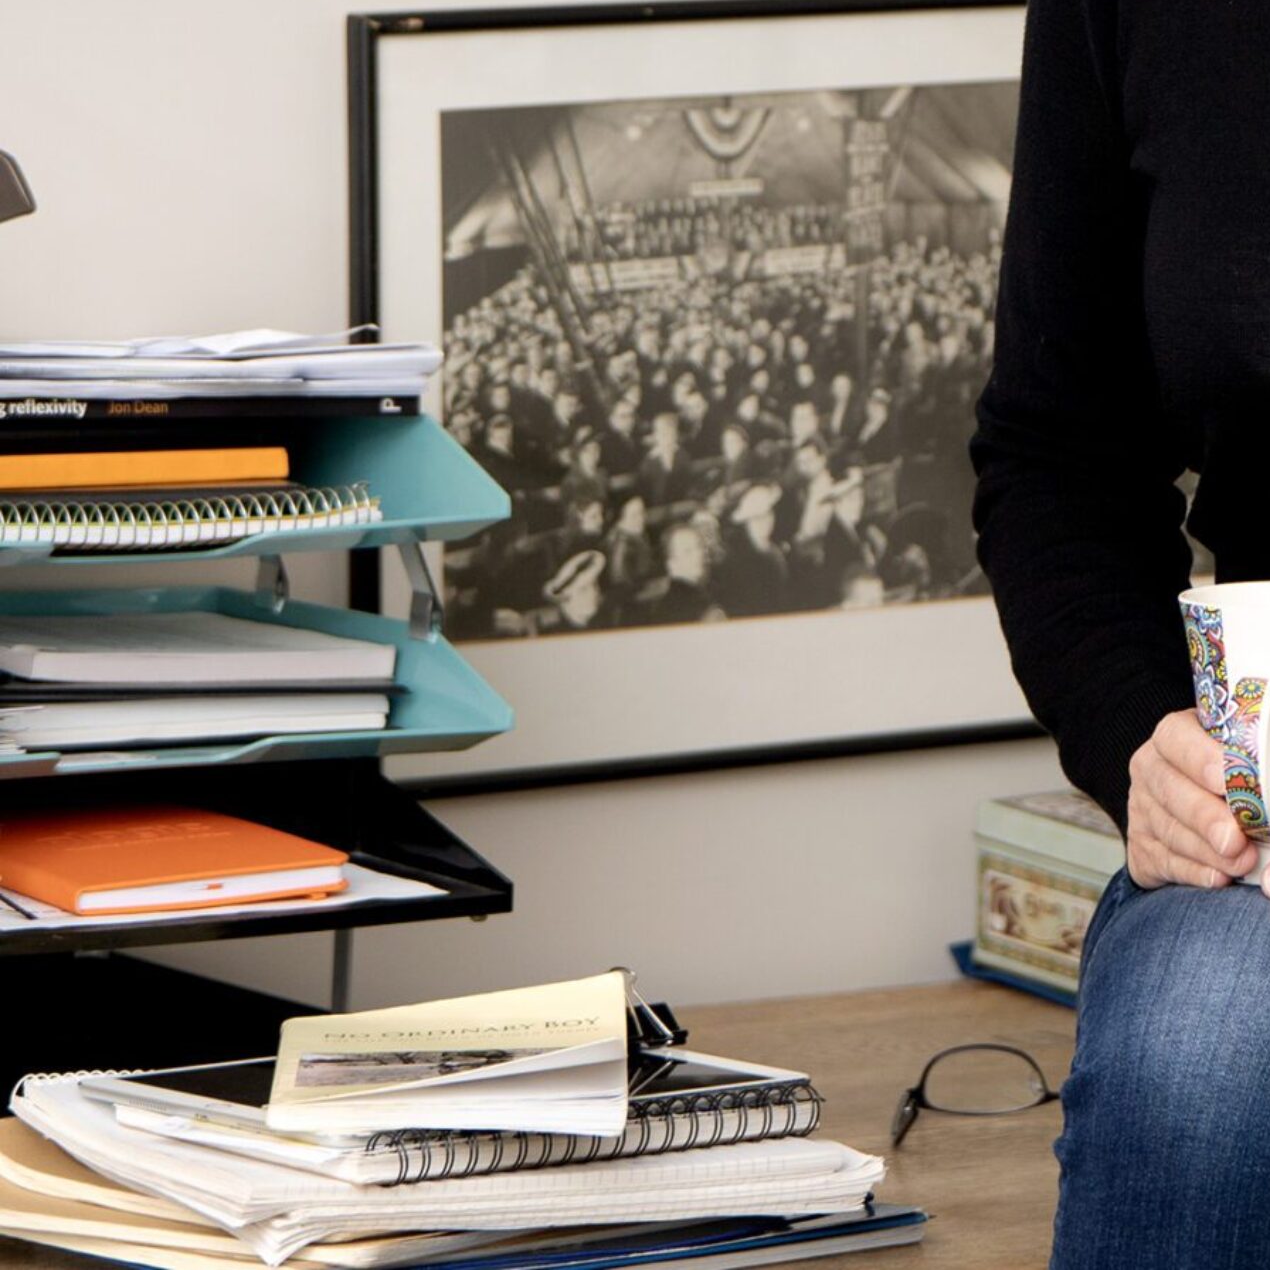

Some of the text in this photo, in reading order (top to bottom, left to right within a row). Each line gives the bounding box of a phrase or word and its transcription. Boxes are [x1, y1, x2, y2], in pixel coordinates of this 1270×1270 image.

[9, 398, 87, 418] reflexivity
[108, 402, 131, 415] Jon
[134, 401, 169, 415] Dean
[324, 1031, 371, 1039] NO
[381, 1023, 534, 1038] ORDINARY
[545, 1015, 600, 1029] BOY
